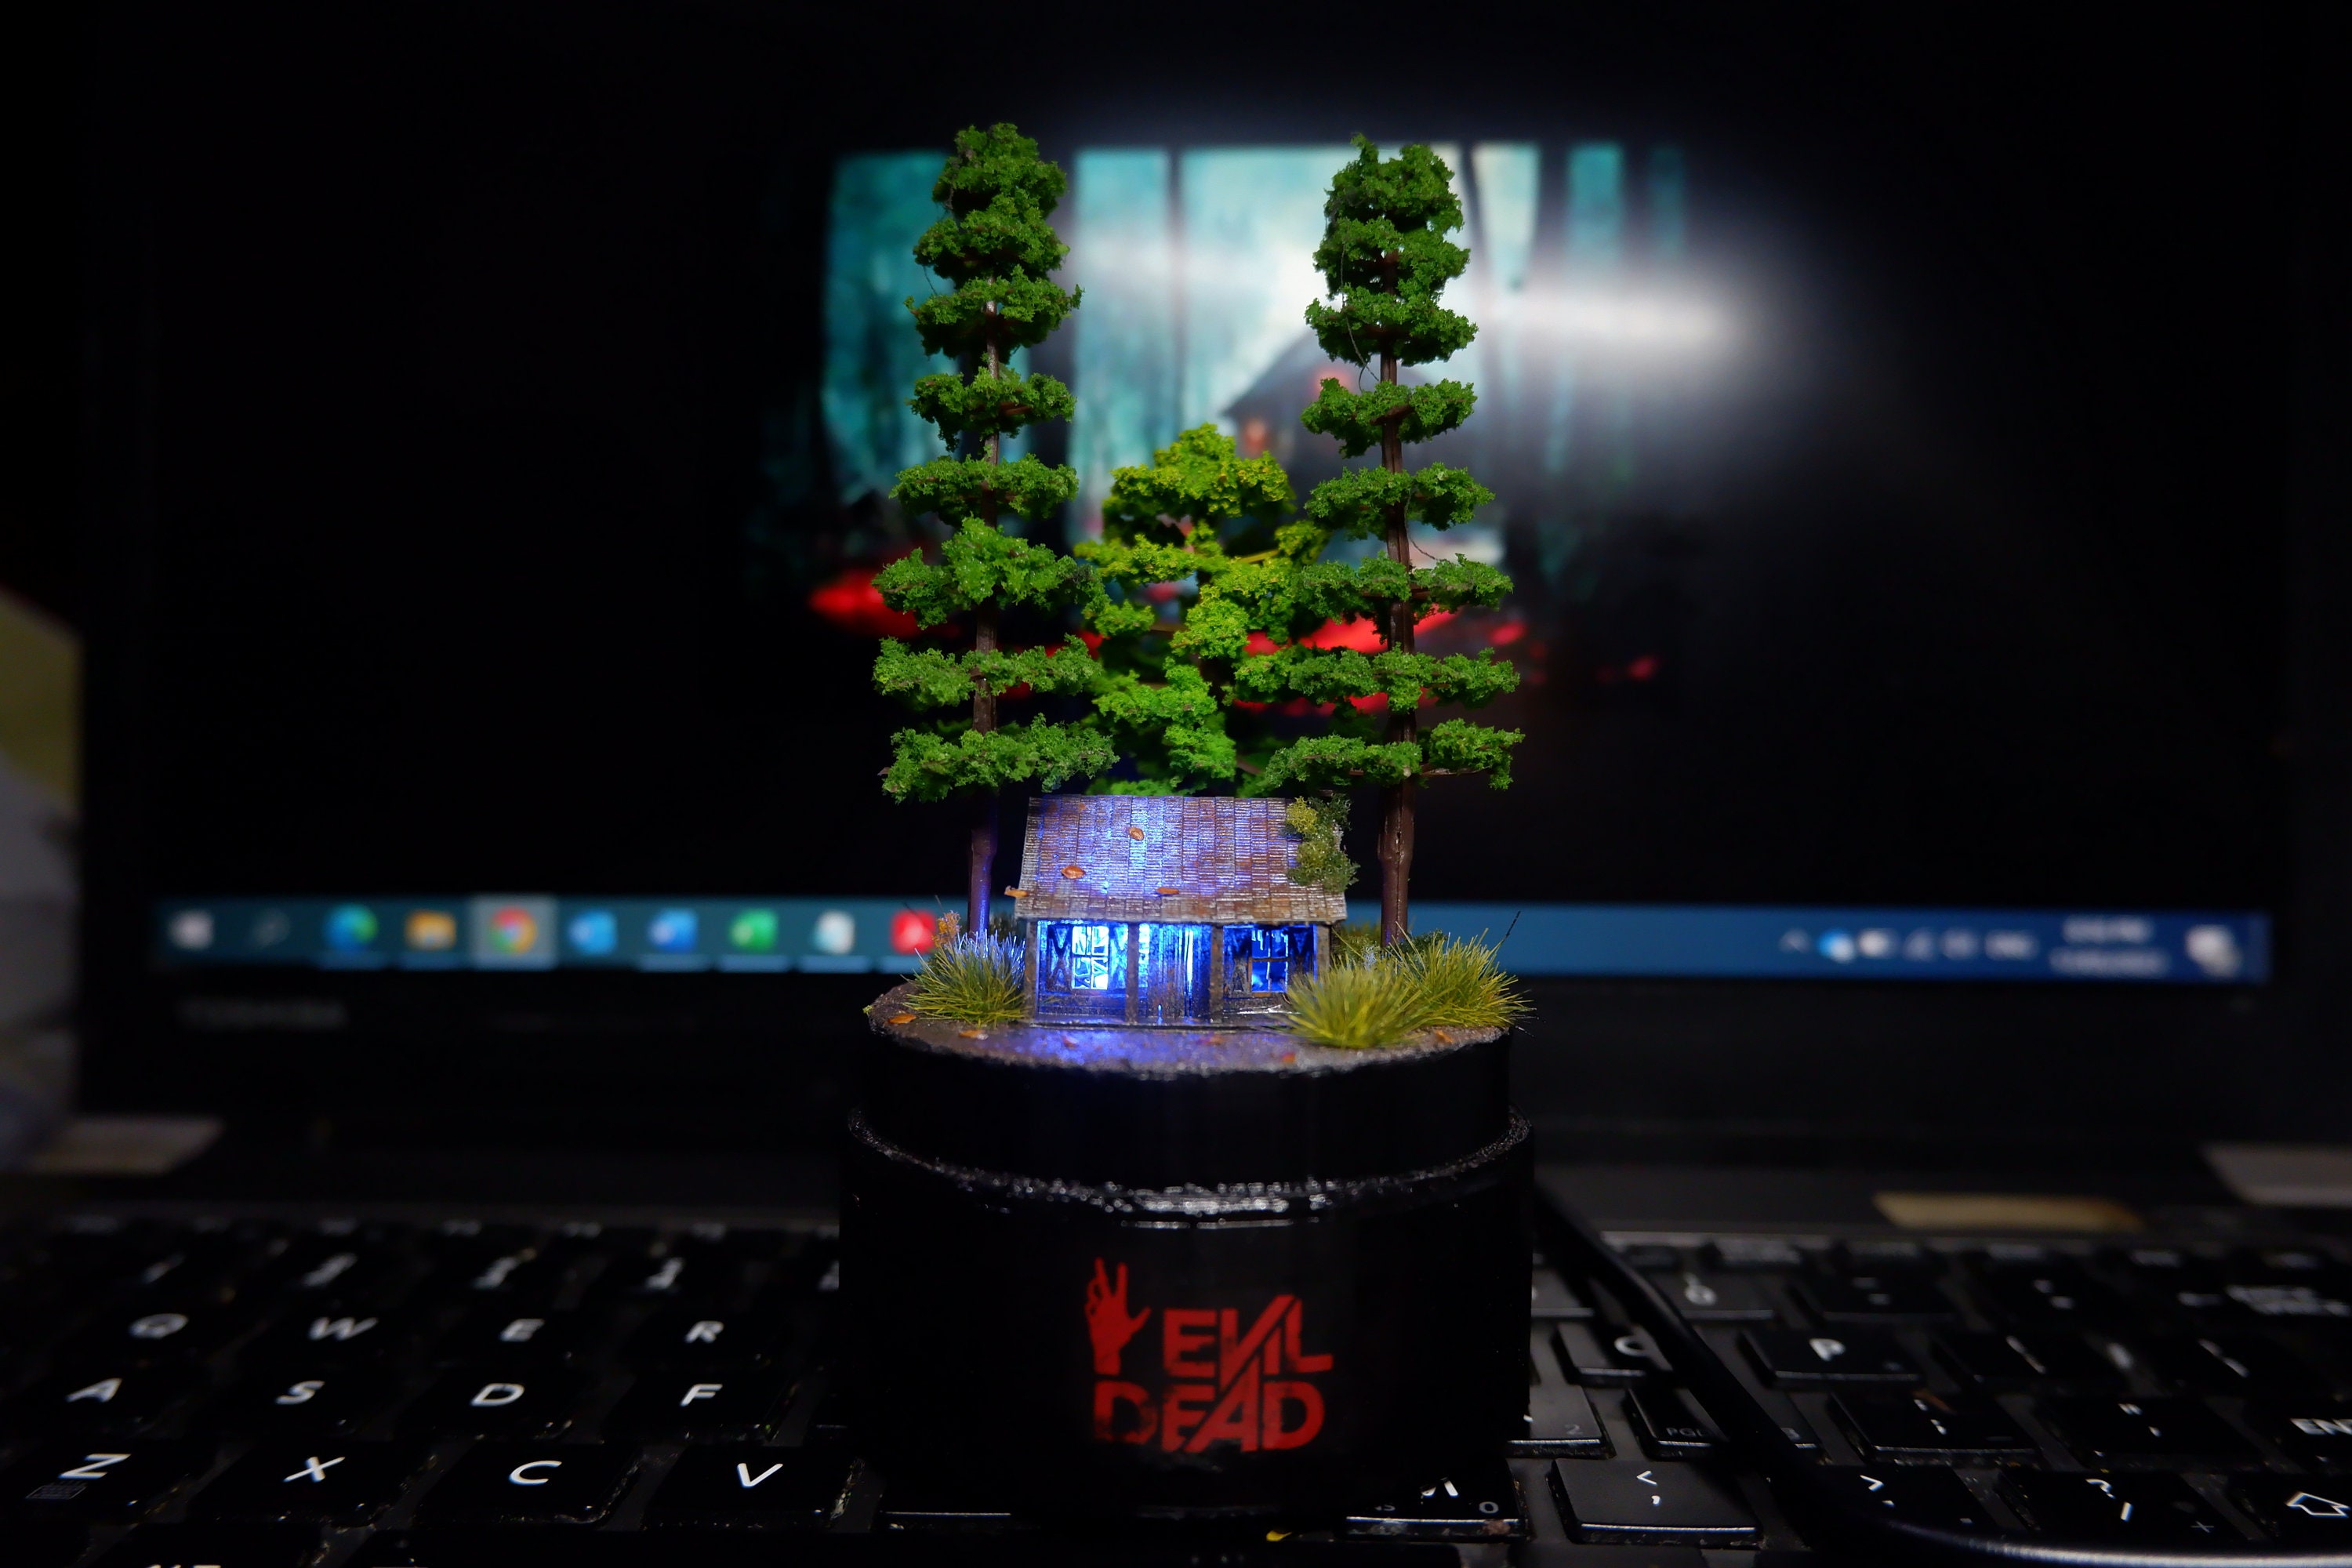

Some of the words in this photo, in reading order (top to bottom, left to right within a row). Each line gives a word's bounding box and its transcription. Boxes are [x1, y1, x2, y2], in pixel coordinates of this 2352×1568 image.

[684, 1320, 724, 1344] R
[1163, 1294, 1334, 1391] EVIL
[65, 1377, 122, 1403] A
[275, 1380, 325, 1405] S
[470, 1382, 524, 1406] D
[680, 1383, 723, 1407] F
[1094, 1357, 1326, 1453] DEAD
[58, 1453, 132, 1479] Z
[282, 1456, 347, 1483] X
[507, 1459, 563, 1486] C
[735, 1462, 784, 1488] V
